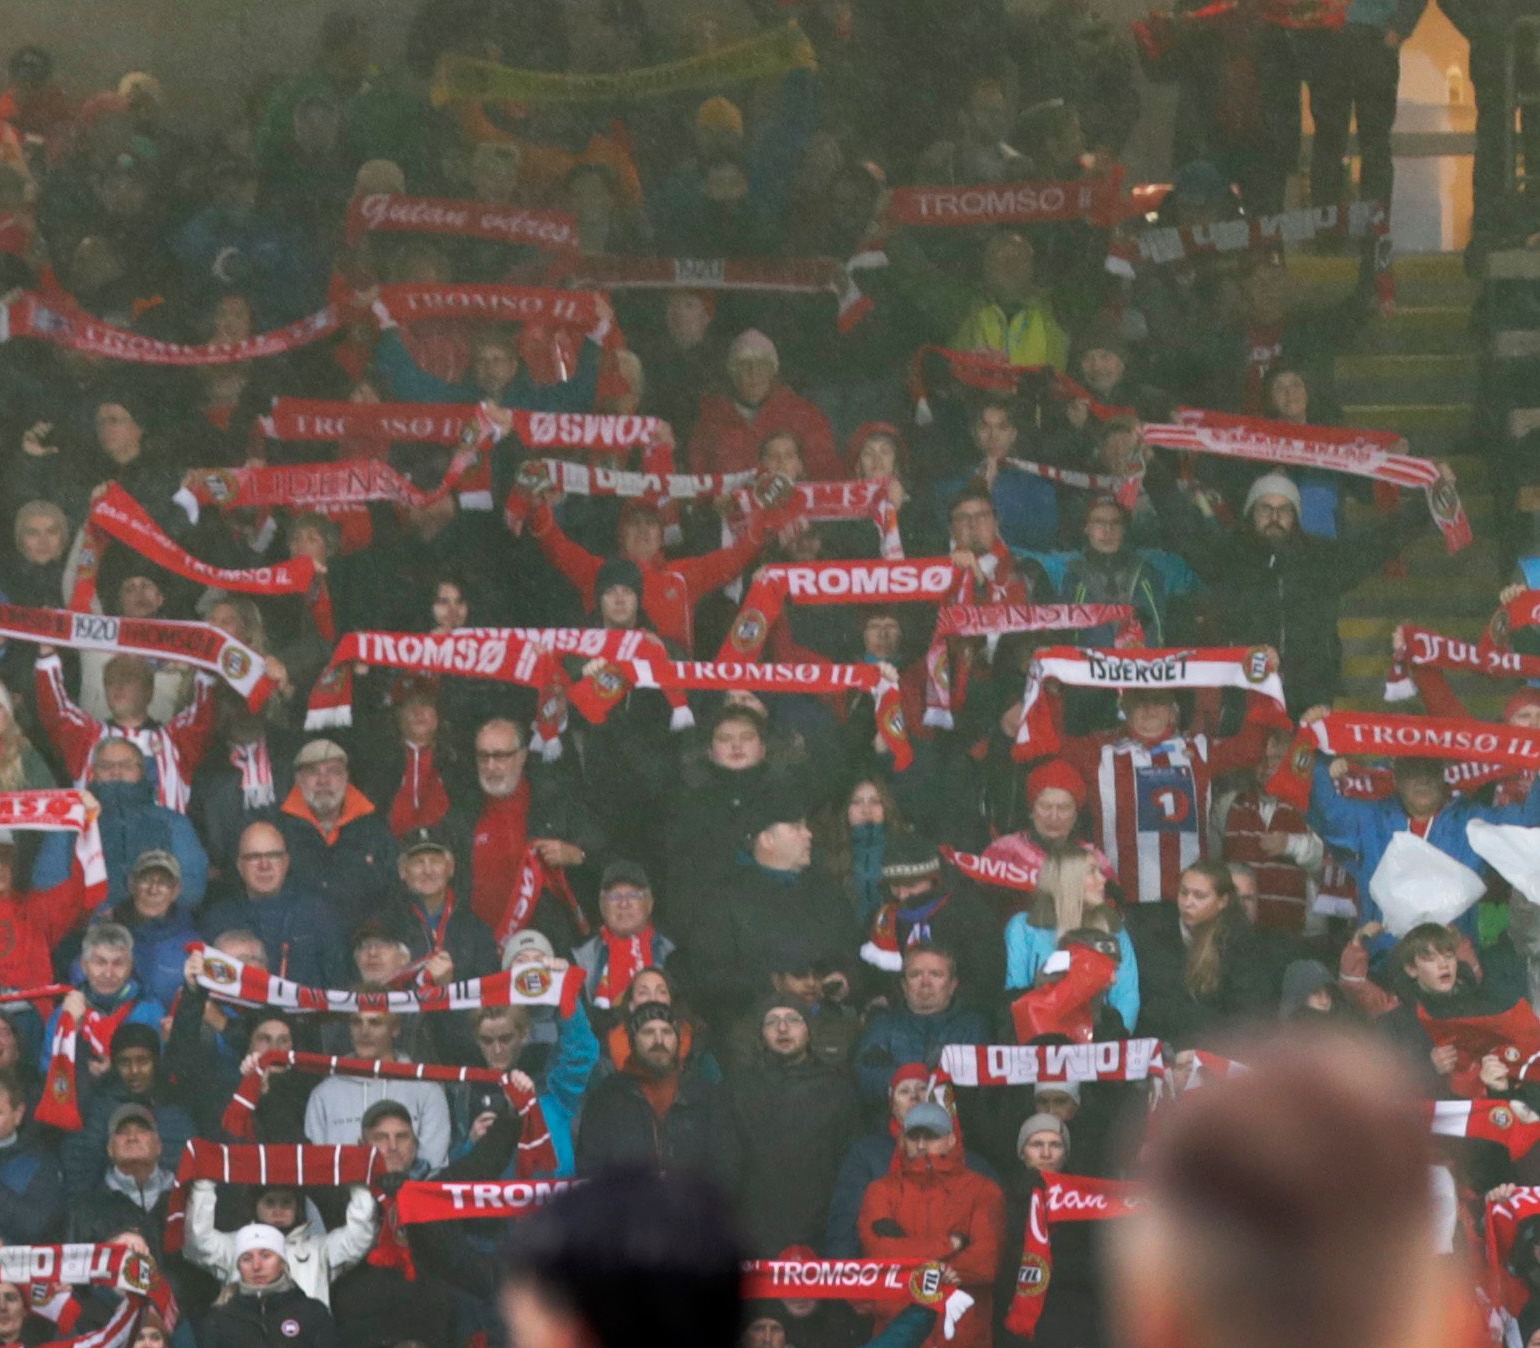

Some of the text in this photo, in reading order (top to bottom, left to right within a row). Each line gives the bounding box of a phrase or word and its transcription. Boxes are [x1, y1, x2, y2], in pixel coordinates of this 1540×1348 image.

[526, 413, 654, 445] ROMSØ
[74, 615, 118, 641] 1920
[356, 633, 508, 674] TROMSØ
[673, 660, 822, 683] TROMSØ
[1345, 723, 1499, 750] TROMSØ
[954, 850, 1037, 885] OMS
[442, 1181, 571, 1210] TROM
[1045, 1184, 1108, 1210] tan
[768, 1260, 905, 1289] TROMSØ IL
